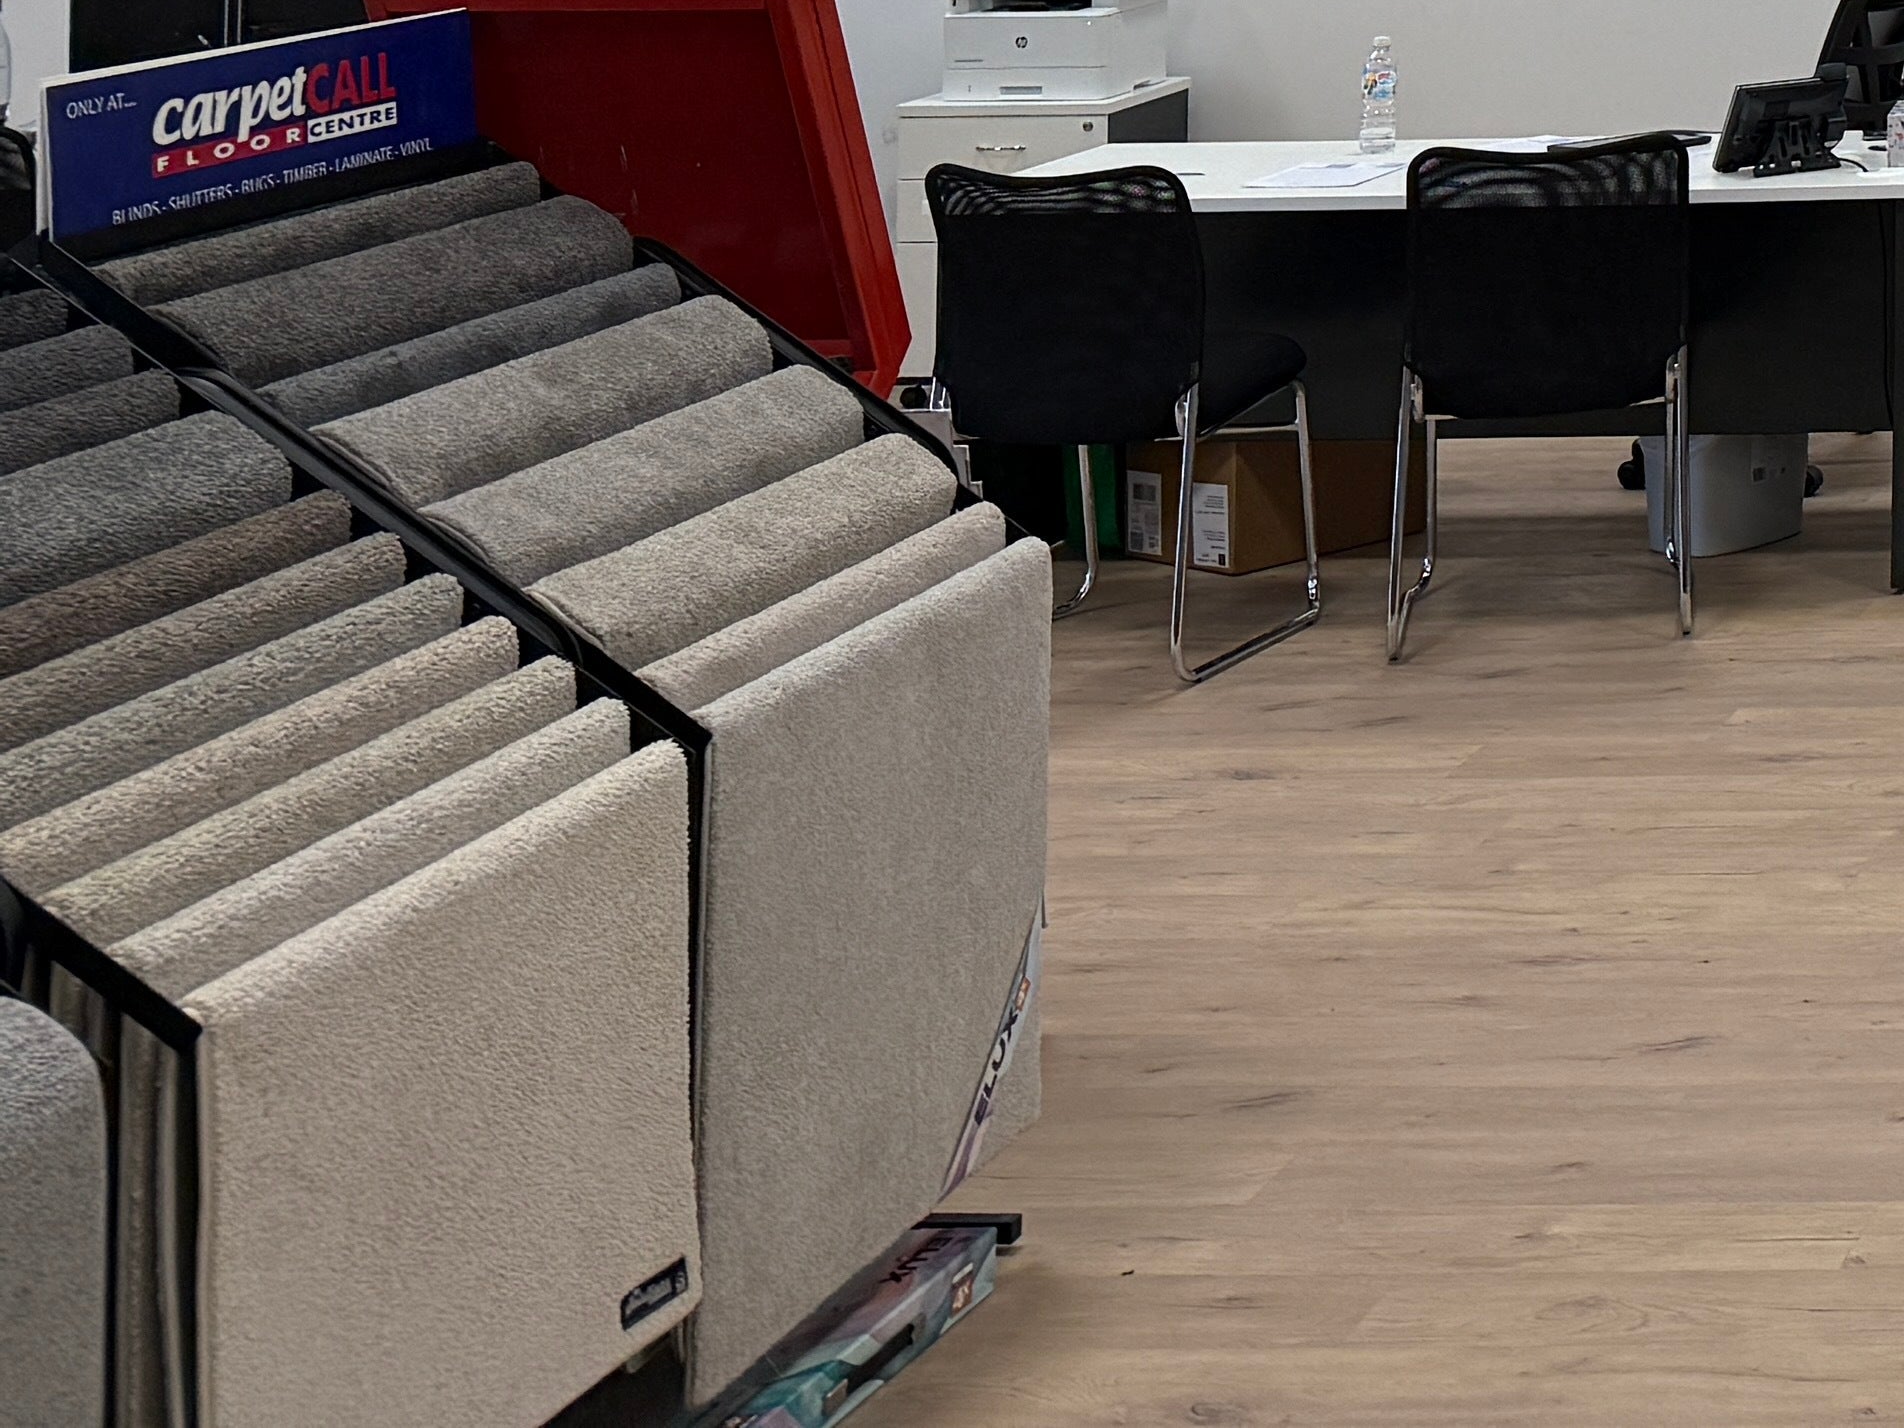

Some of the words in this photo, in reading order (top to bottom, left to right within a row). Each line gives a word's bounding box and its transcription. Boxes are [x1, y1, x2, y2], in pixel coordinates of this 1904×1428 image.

[67, 97, 105, 119] ONLY
[157, 128, 301, 173] FLOOR
[309, 106, 395, 138] CENTRE
[168, 184, 232, 212] SHUTTERS
[283, 162, 327, 185] TIMBER
